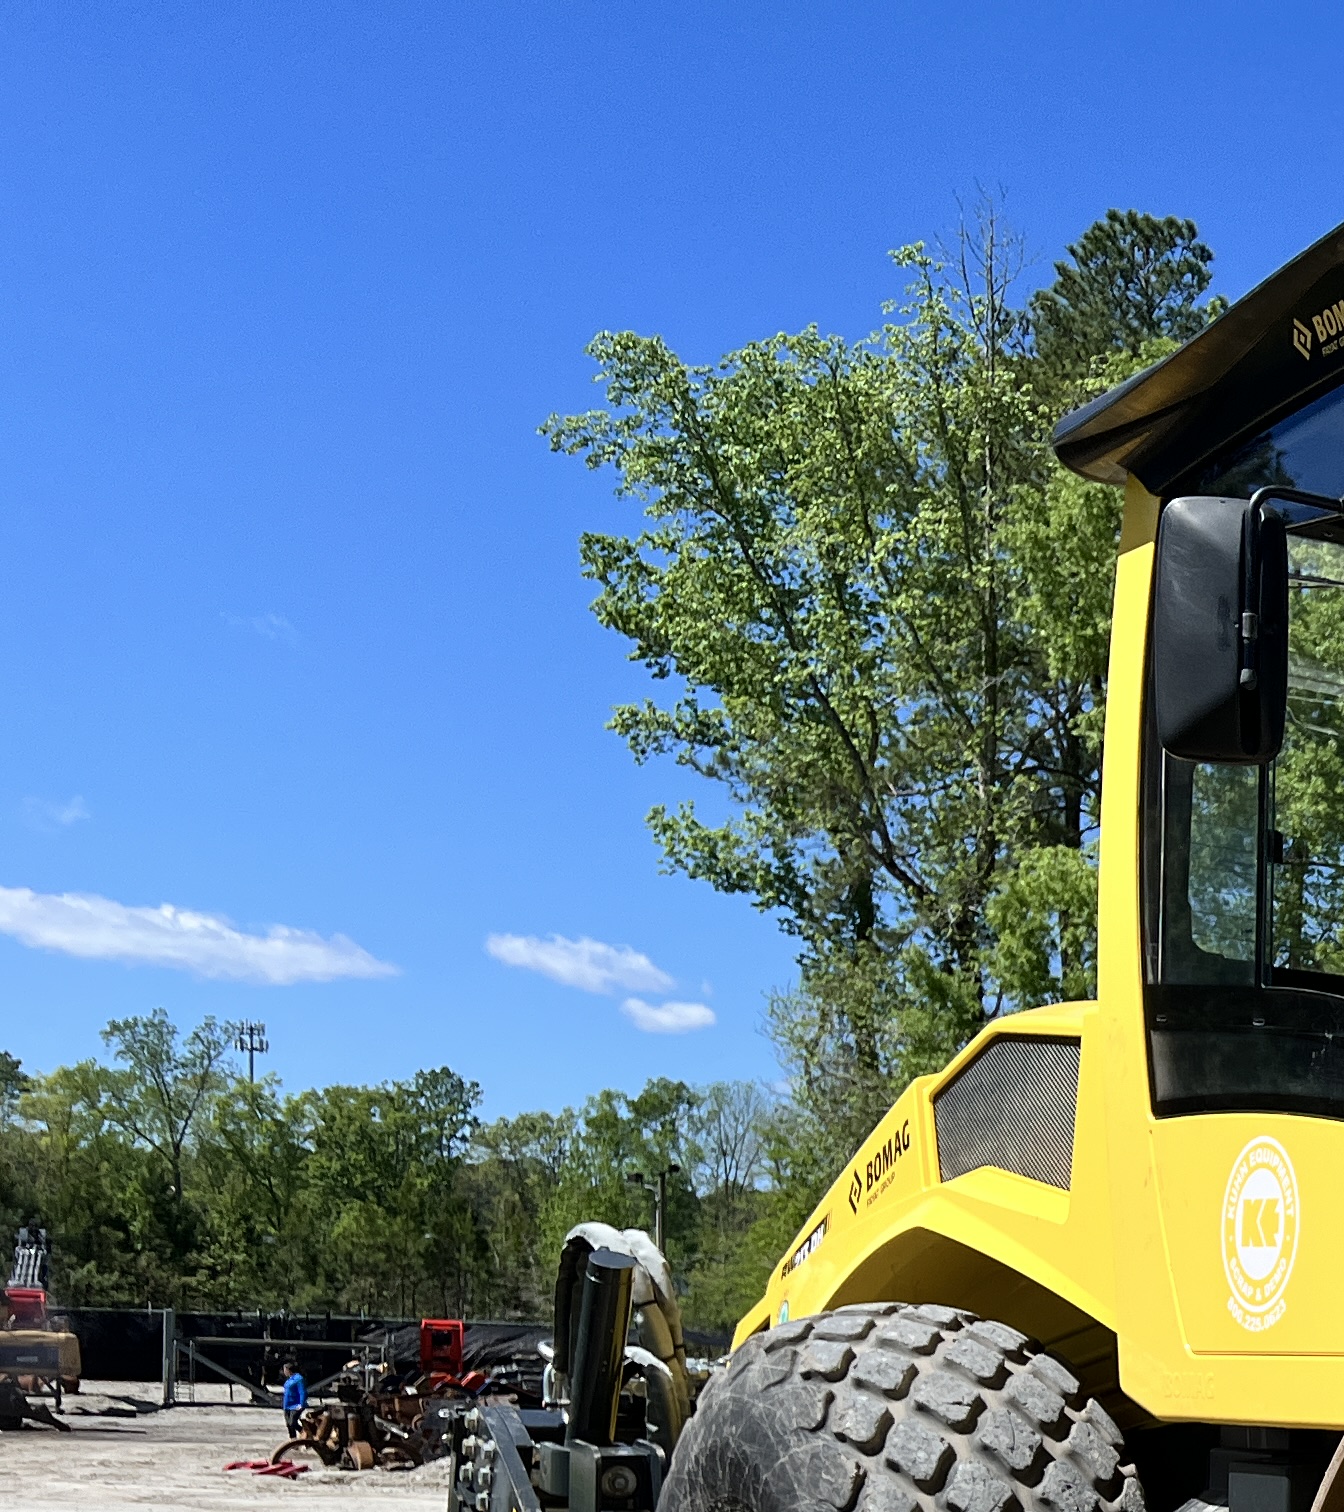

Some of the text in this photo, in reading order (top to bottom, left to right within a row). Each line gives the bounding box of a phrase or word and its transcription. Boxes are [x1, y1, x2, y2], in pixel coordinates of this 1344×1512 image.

[866, 1118, 910, 1192] BOMAG
[1227, 1147, 1295, 1220] KUHN EQUIPMENT
[1229, 1257, 1287, 1301] SCRAP & DEMO
